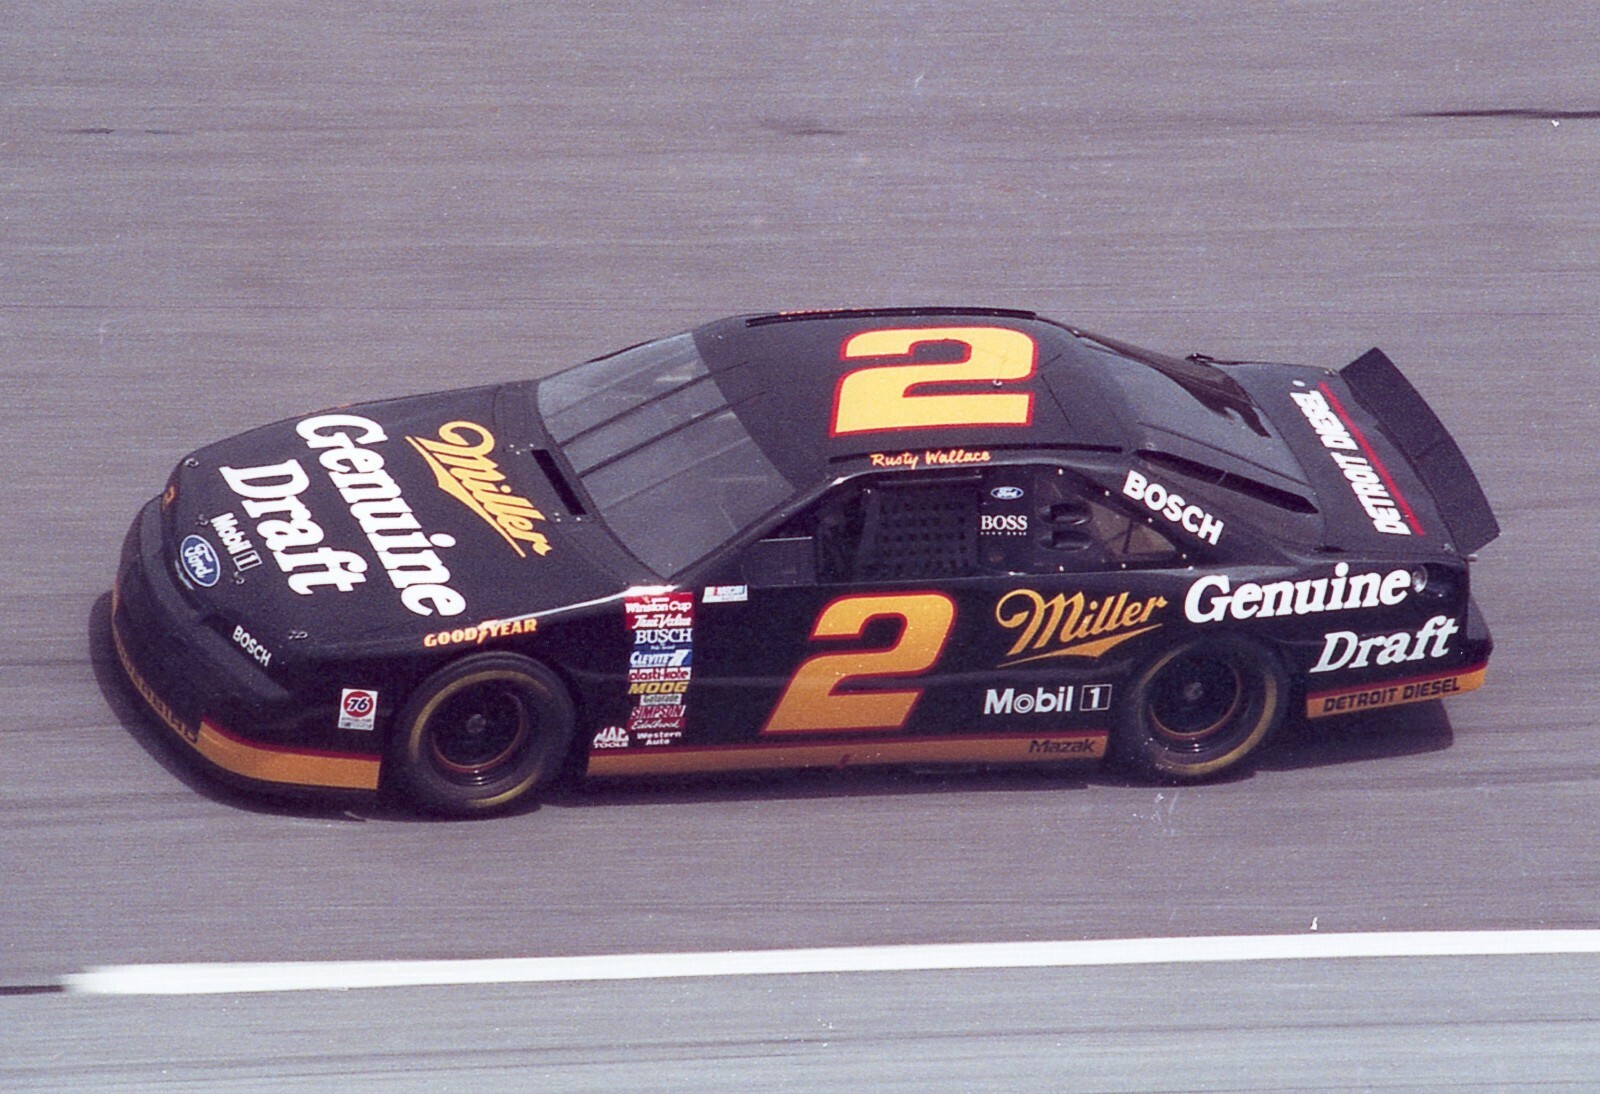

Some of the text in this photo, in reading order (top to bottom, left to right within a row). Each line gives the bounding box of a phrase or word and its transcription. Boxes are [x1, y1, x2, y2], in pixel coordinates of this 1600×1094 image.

[829, 325, 1038, 437] 2
[869, 448, 991, 470] Rusty Wallace
[414, 421, 552, 556] Miller
[1122, 470, 1224, 546] BOSCH
[1330, 452, 1411, 535] DETROIT
[210, 512, 252, 555] Mobil
[219, 459, 367, 595] Draft
[296, 414, 466, 616] Genuine
[981, 514, 1028, 531] BOSS
[183, 541, 216, 581] Ford
[1184, 562, 1411, 623] Genuine
[423, 618, 538, 647] GOODYEAR
[634, 628, 692, 644] BUSCH
[996, 588, 1168, 656] Miller
[233, 625, 272, 667] BOSCH
[760, 590, 957, 735] 2
[1309, 615, 1459, 673] Draft
[346, 696, 371, 713] 76
[628, 681, 689, 694] MOOG
[984, 686, 1074, 714] Mobil
[1323, 677, 1460, 712] DETROIT DIESEL
[593, 726, 630, 742] MAC
[1028, 739, 1095, 753] Mazak
